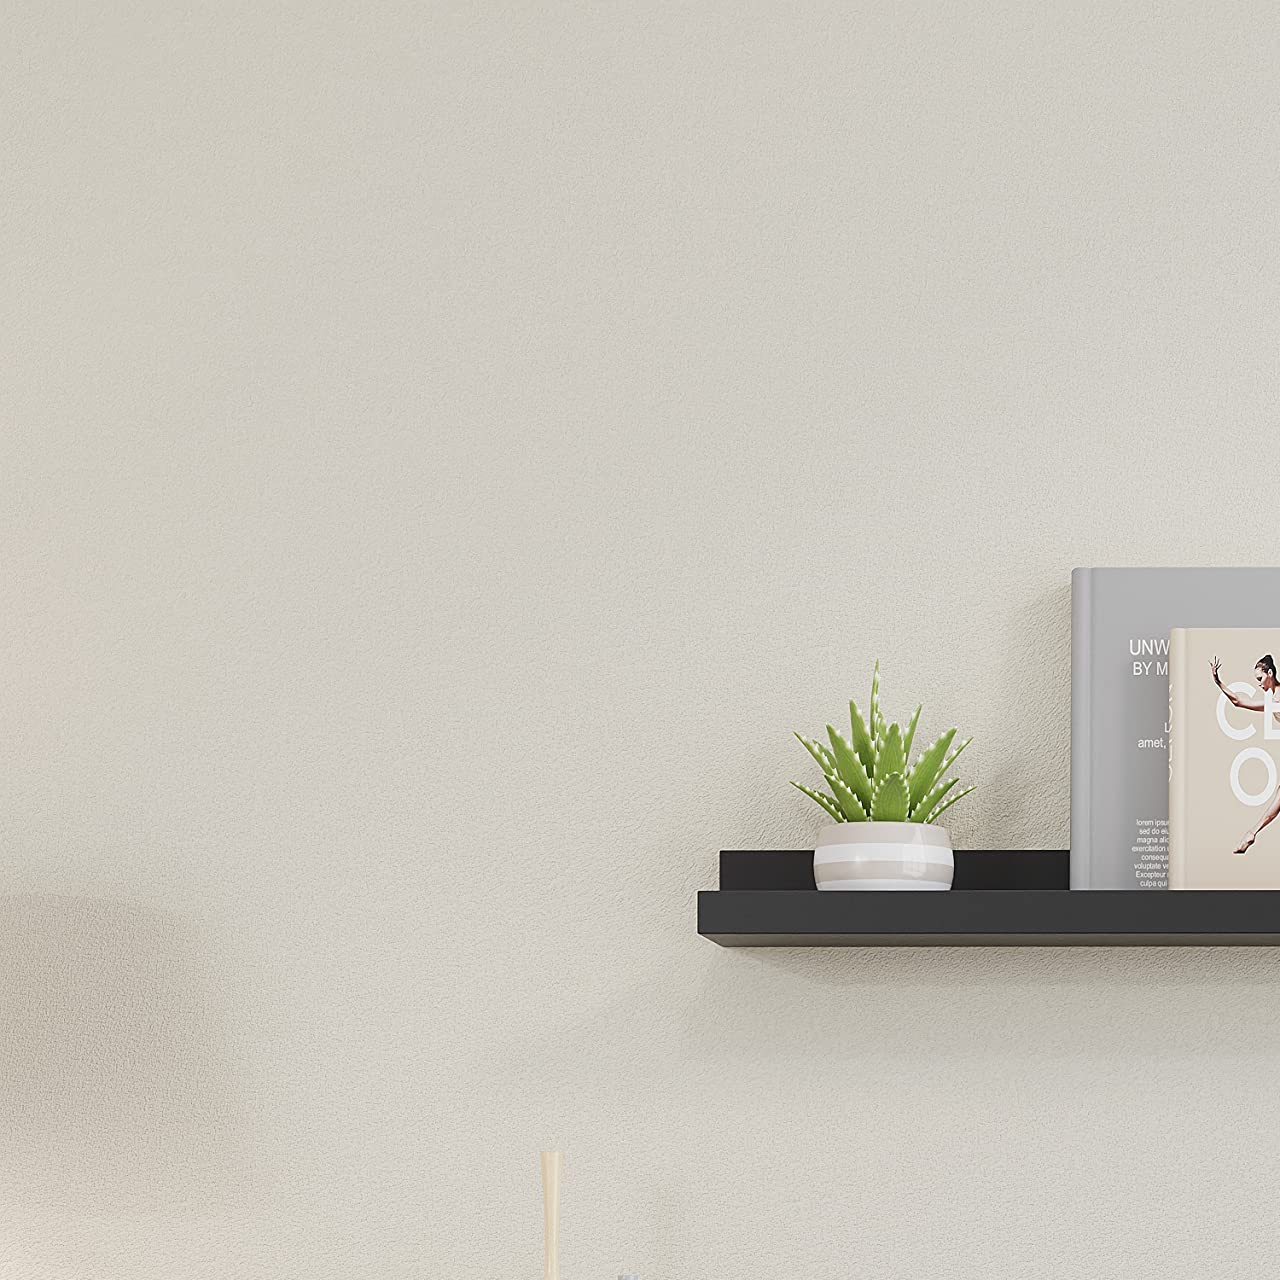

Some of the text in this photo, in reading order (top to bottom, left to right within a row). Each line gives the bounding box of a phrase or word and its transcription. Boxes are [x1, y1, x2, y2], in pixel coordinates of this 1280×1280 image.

[1133, 661, 1153, 676] BY
[1137, 738, 1167, 749] amet,
[1140, 880, 1157, 888] culpa
